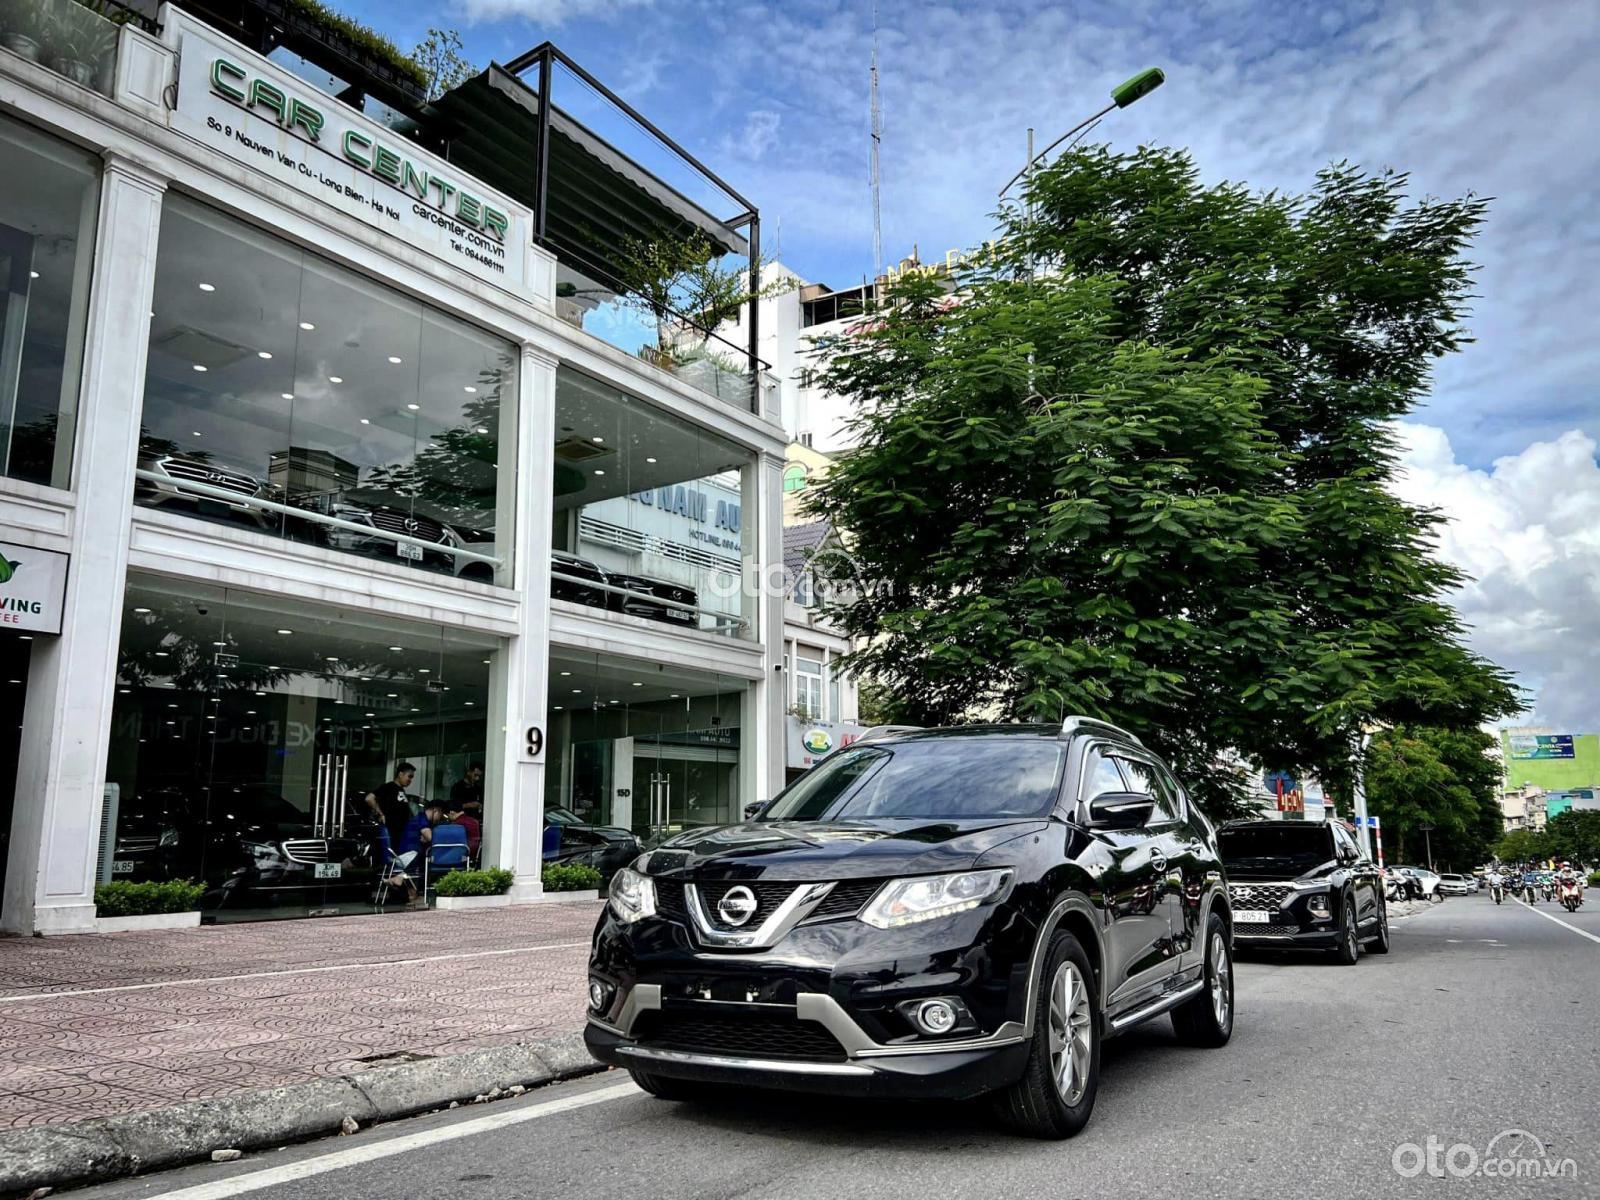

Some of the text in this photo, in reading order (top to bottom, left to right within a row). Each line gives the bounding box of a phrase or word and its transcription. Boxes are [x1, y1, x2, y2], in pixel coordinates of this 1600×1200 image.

[207, 116, 222, 131] So
[225, 125, 232, 136] 9
[236, 130, 274, 158] Nguyen
[277, 151, 296, 170] Van
[299, 163, 312, 177] Cu
[320, 173, 342, 193] Long
[345, 186, 365, 203] Bien
[372, 199, 384, 213] Ha
[386, 206, 400, 221] Noi
[210, 58, 509, 239] CAR CENTER
[412, 204, 505, 258] carcenter.com.vn
[657, 485, 706, 523] NAM
[0, 613, 20, 623] EE
[528, 726, 543, 756] 9
